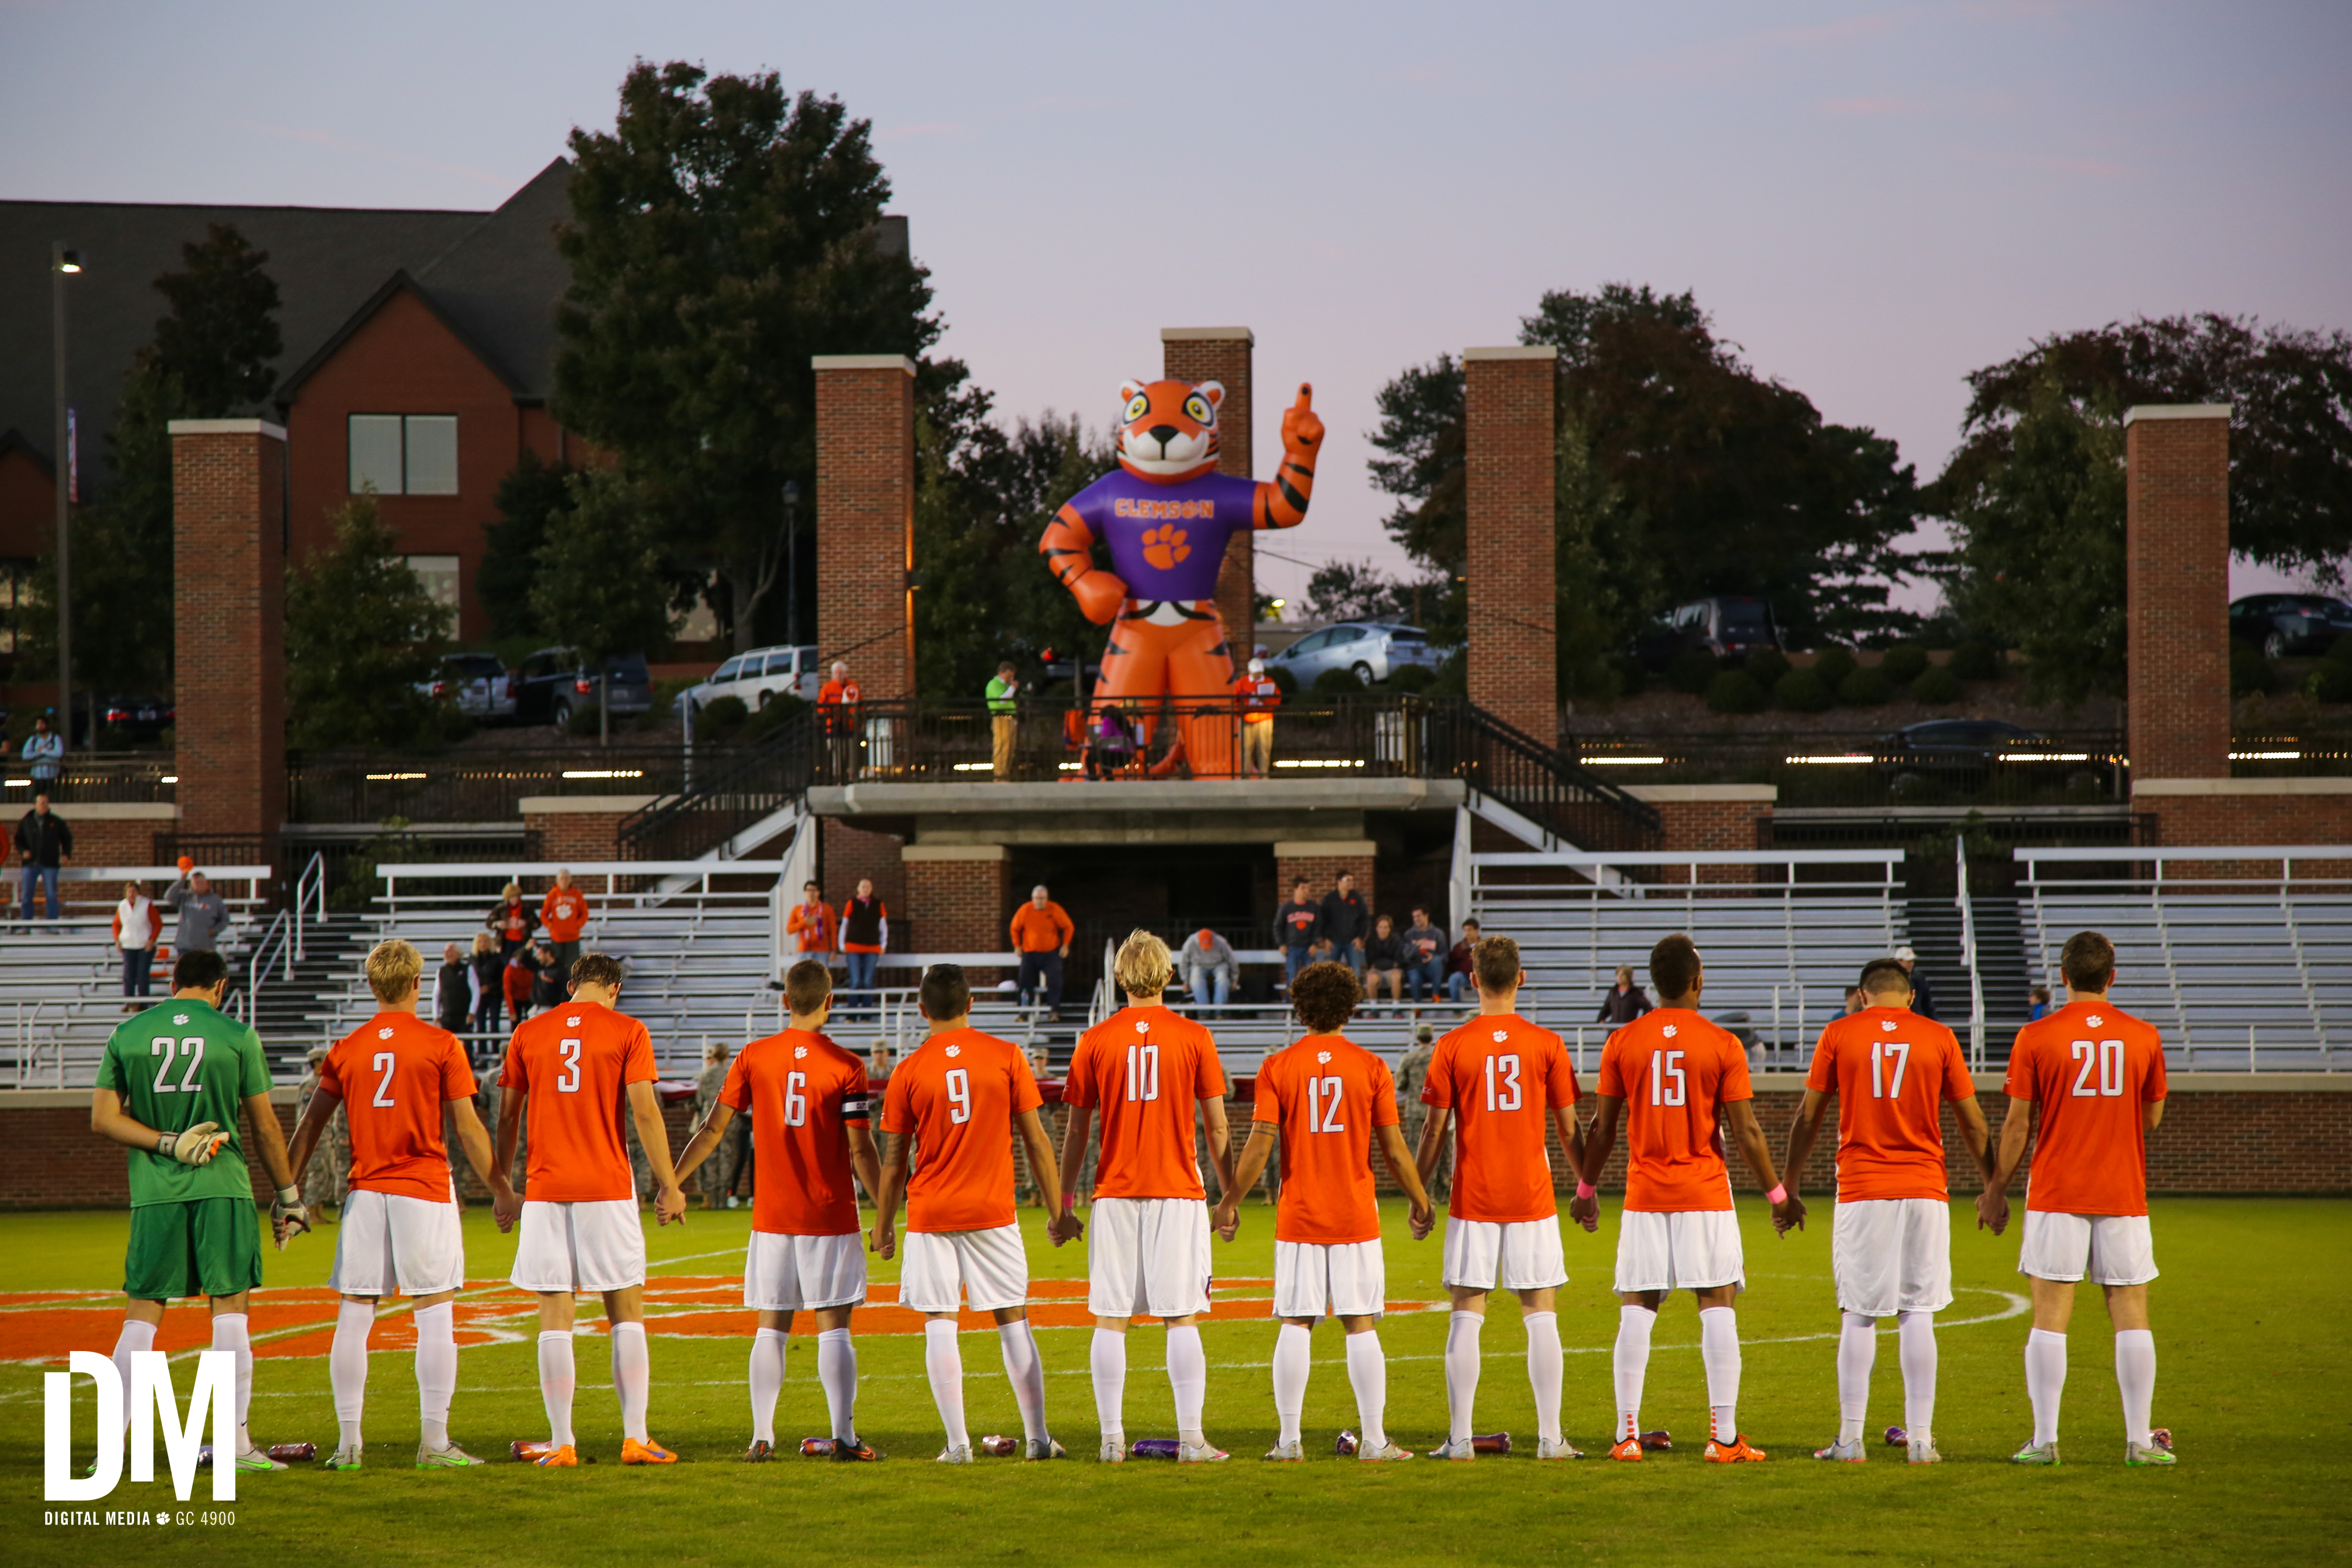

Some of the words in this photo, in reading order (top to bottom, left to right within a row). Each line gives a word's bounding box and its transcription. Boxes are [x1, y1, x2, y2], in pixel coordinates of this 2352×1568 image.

[151, 1036, 205, 1093] 22
[372, 1052, 395, 1108] 2
[557, 1038, 581, 1093] 3
[1126, 1044, 1159, 1102] 10
[1485, 1054, 1522, 1112] 13
[1651, 1050, 1686, 1106] 15
[1871, 1041, 1910, 1099] 17
[2071, 1039, 2125, 1097] 20
[784, 1071, 806, 1127] 6
[945, 1068, 971, 1125] 9
[1308, 1076, 1344, 1133] 12
